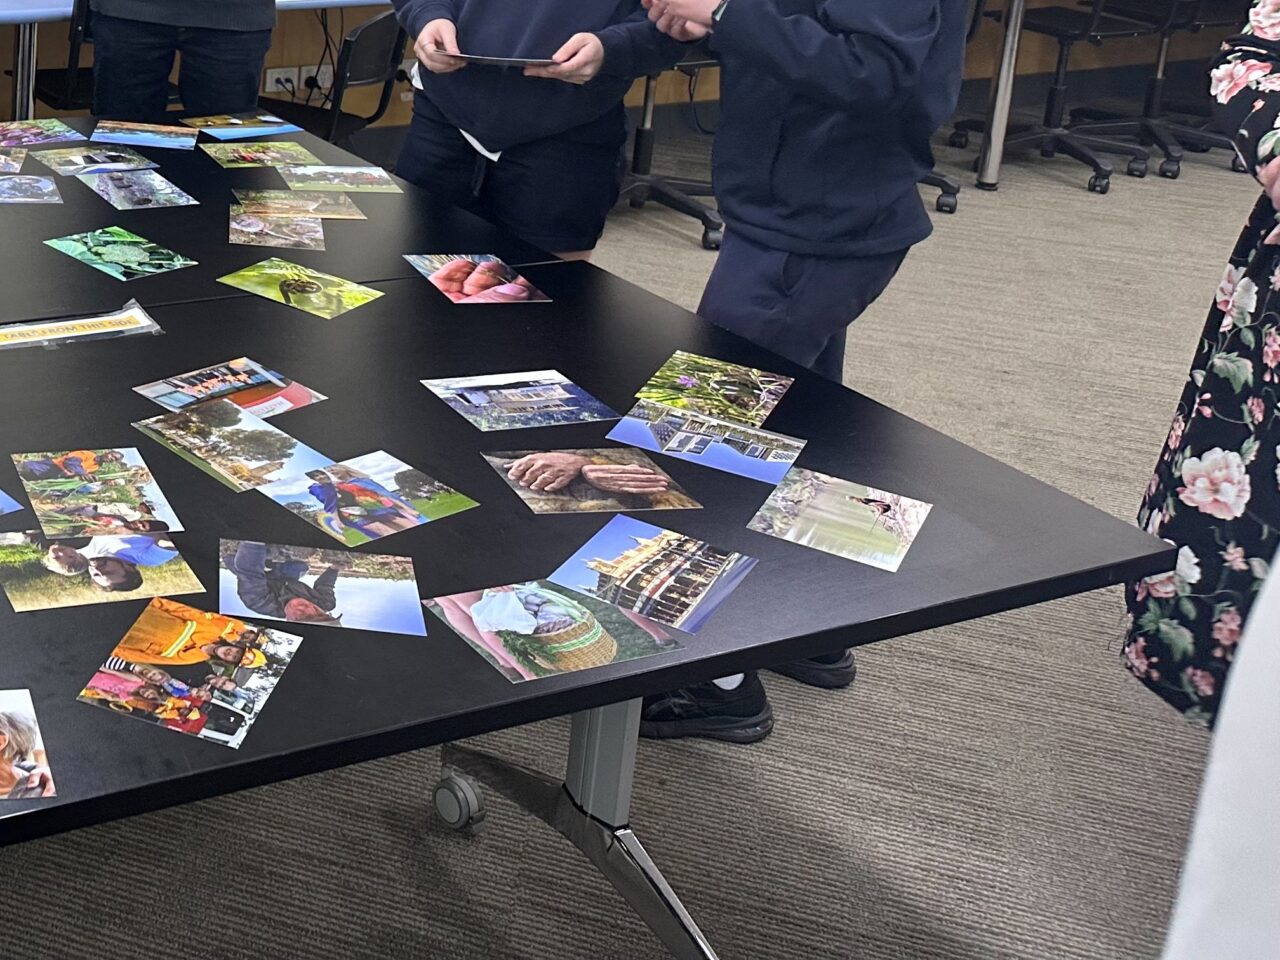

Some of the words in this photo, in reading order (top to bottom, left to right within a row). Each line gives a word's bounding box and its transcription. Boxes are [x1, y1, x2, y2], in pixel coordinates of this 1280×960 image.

[3, 330, 39, 340] TABLE
[41, 325, 78, 336] FROM
[81, 321, 106, 331] THIS
[109, 317, 133, 328] SIDE
